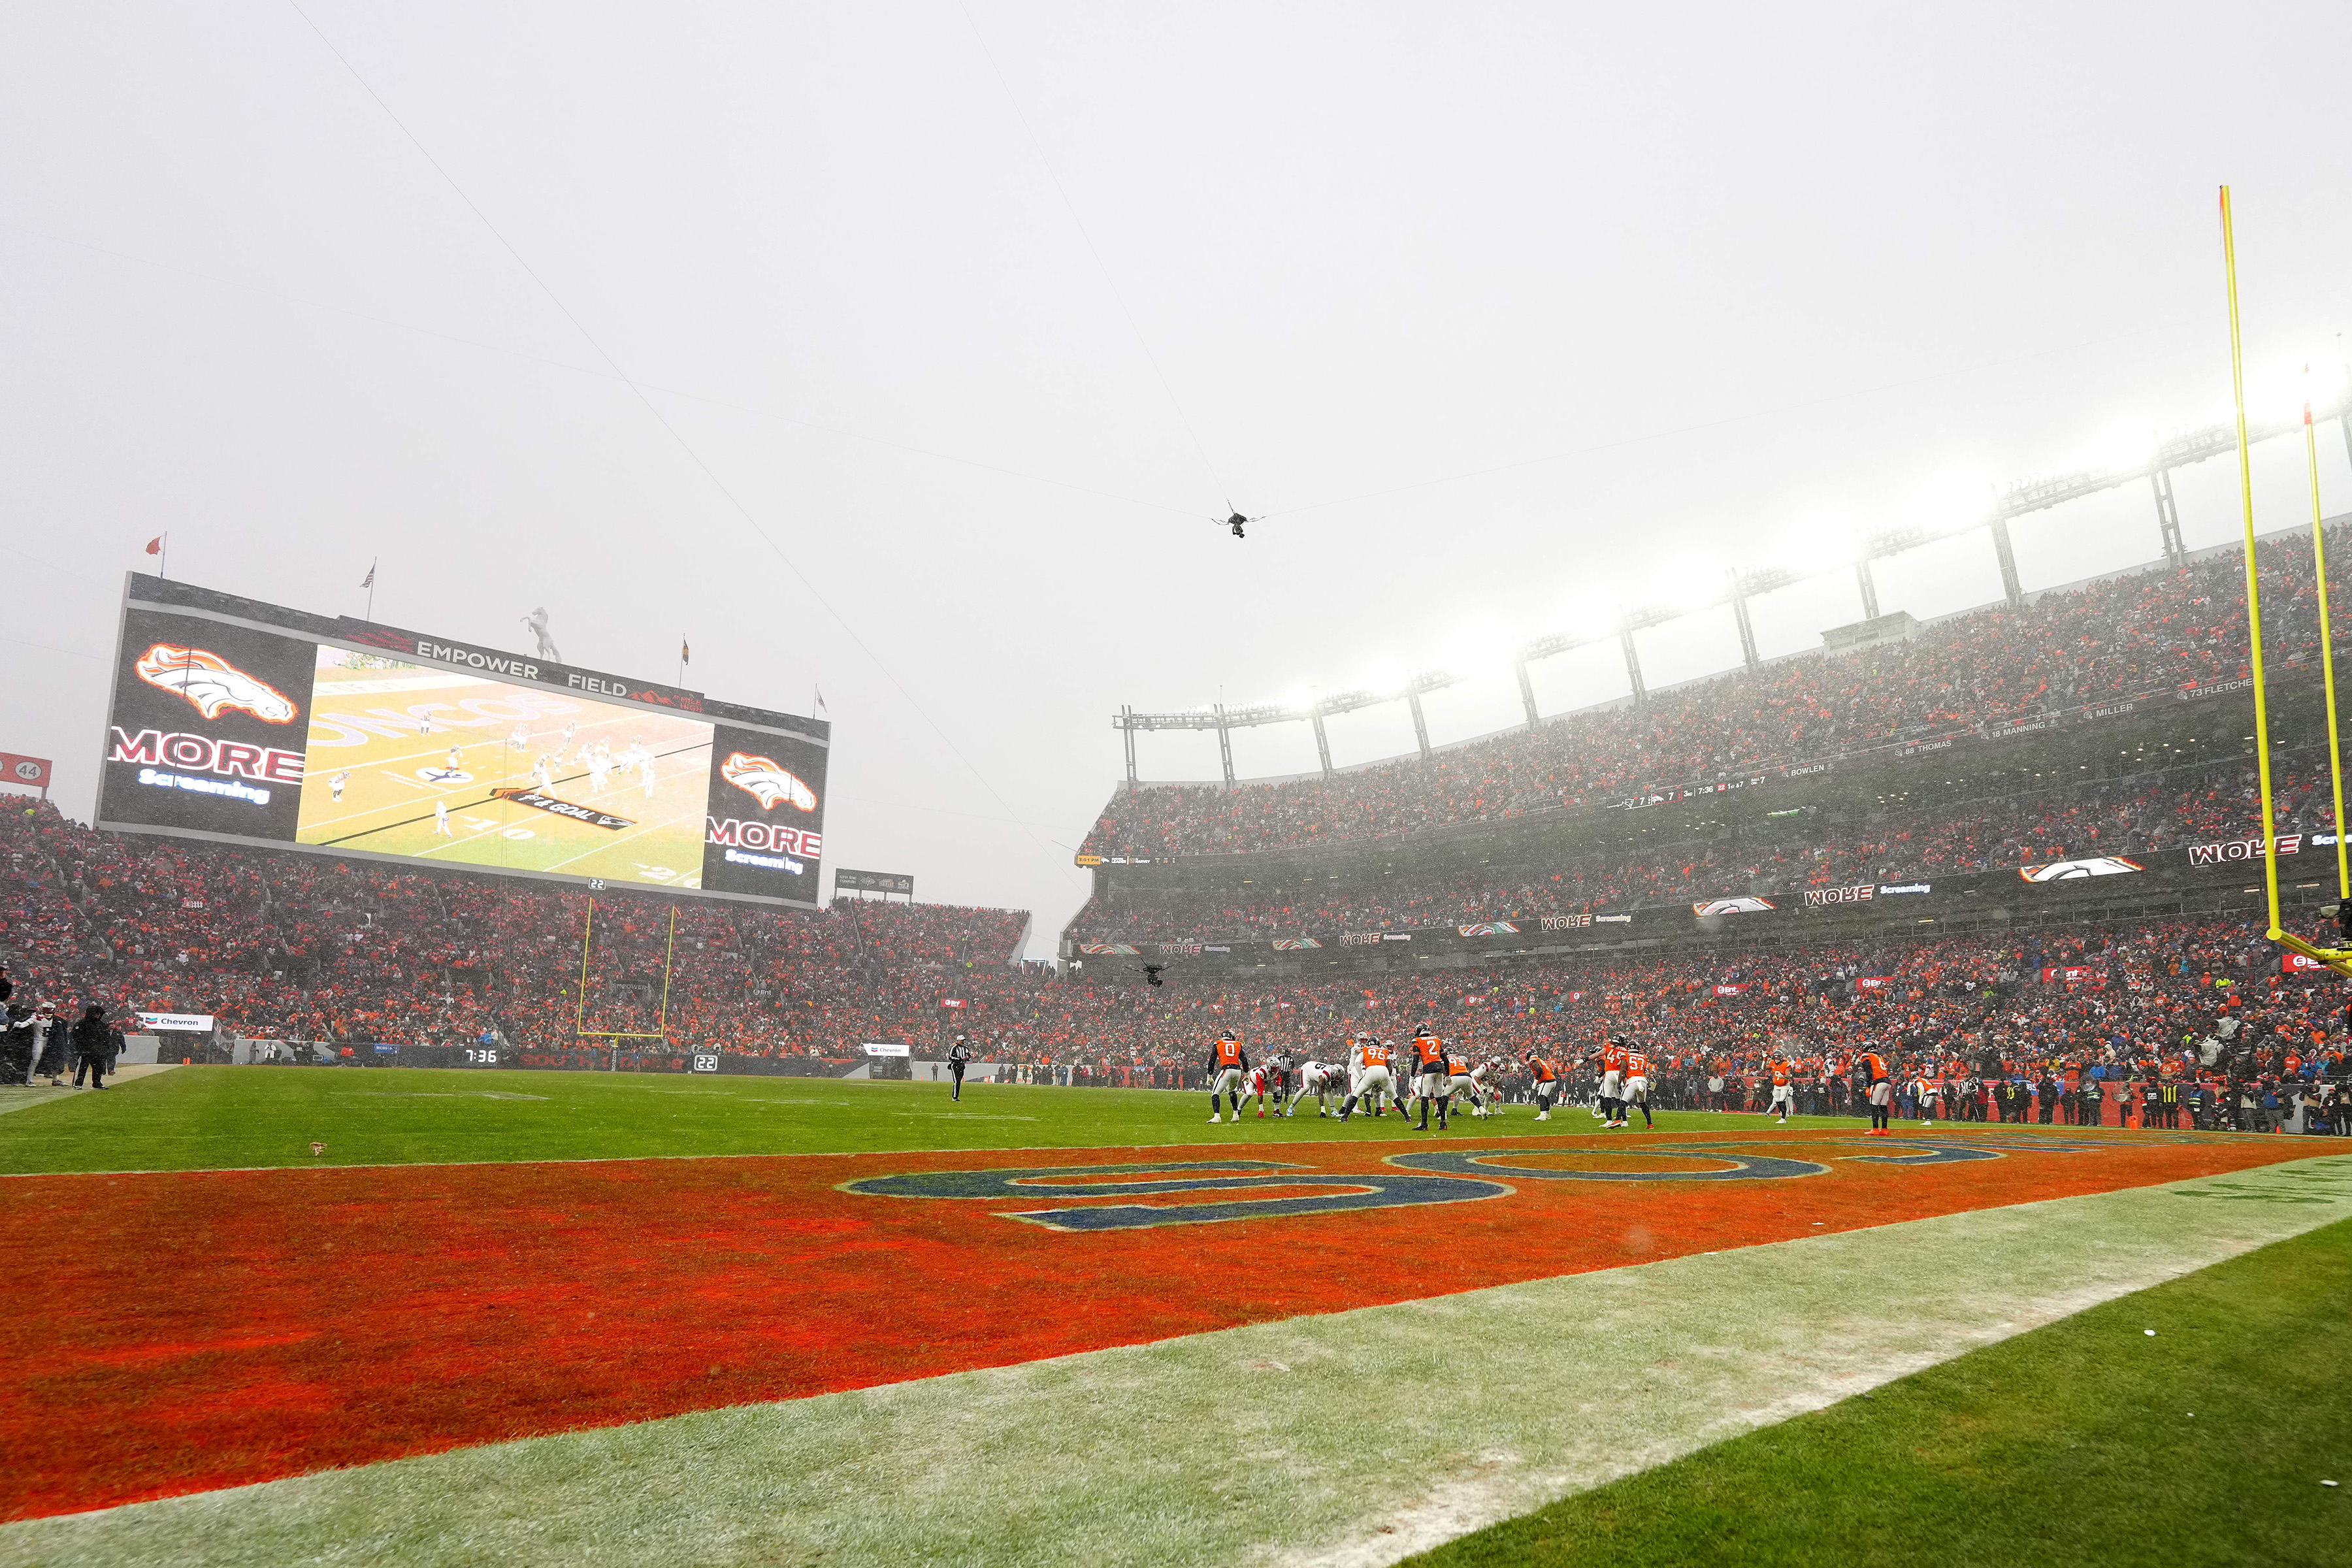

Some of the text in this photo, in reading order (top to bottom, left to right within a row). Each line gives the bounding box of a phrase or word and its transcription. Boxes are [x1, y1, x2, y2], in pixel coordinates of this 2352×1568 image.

[417, 641, 627, 697] EMPOWER FIELD
[2190, 677, 2262, 698] 73 FLETCHE
[680, 696, 701, 706] MILE
[680, 703, 702, 713] HIGH
[2096, 703, 2133, 717] MILLER
[2003, 721, 2046, 736] MANNING
[1918, 740, 1952, 752] THOMAS
[107, 726, 306, 785] MORE
[19, 764, 37, 777] 44
[1791, 764, 1824, 776] BOWLEN
[138, 768, 270, 805] Screaming
[1698, 786, 1714, 794] 7:36
[1668, 792, 1674, 800] 7
[549, 804, 595, 820] GOAL
[705, 816, 821, 859] MORE
[725, 849, 804, 875] Screaming
[591, 879, 604, 889] 22
[1880, 883, 1931, 894] Screaming
[1595, 914, 1631, 923] Screaming
[1225, 1043, 1235, 1056] 0
[1367, 1048, 1385, 1060] 96
[1426, 1040, 1438, 1055] 2
[466, 1049, 497, 1062] 7:36
[1448, 1057, 1465, 1067] 93
[1607, 1049, 1625, 1065] 49
[698, 1057, 714, 1069] 22
[1629, 1056, 1644, 1071] 57
